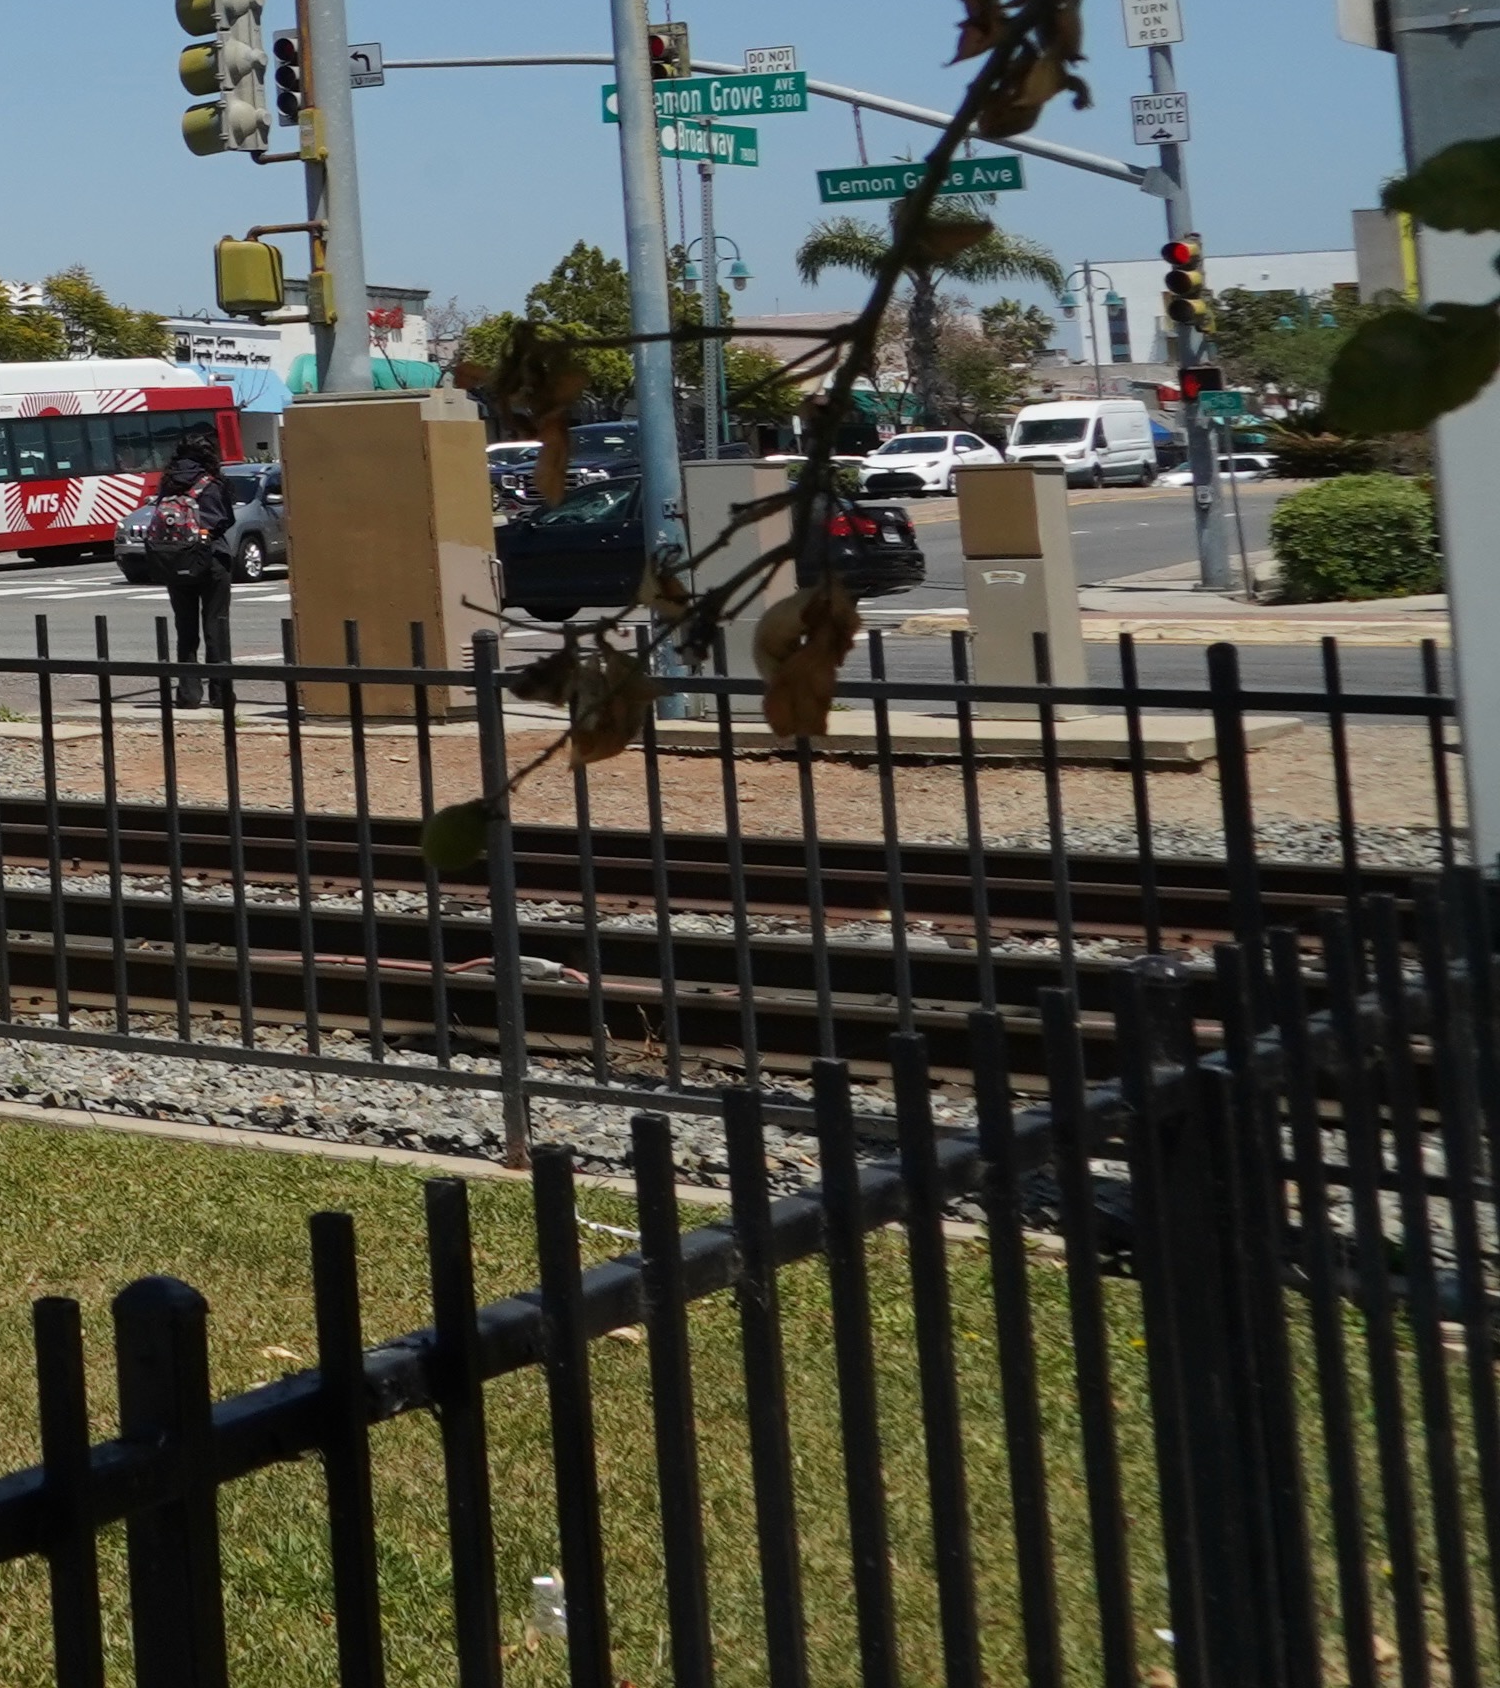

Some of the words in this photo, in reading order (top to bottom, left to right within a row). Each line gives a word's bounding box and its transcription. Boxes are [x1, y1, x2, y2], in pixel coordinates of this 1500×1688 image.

[1132, 2, 1168, 15] TURN
[1143, 16, 1162, 27] ON
[1139, 28, 1169, 41] RED
[749, 52, 765, 64] DO
[768, 49, 790, 62] NOT
[773, 76, 796, 92] AVE
[653, 88, 703, 116] emon
[709, 80, 764, 113] Grove
[769, 93, 801, 109] 3300
[1133, 96, 1185, 111] TRUCK
[1135, 111, 1186, 127] ROUTE
[826, 176, 897, 196] Lemon
[902, 169, 966, 192] Gre
[971, 166, 1013, 186] Ave
[26, 493, 59, 514] MTS
